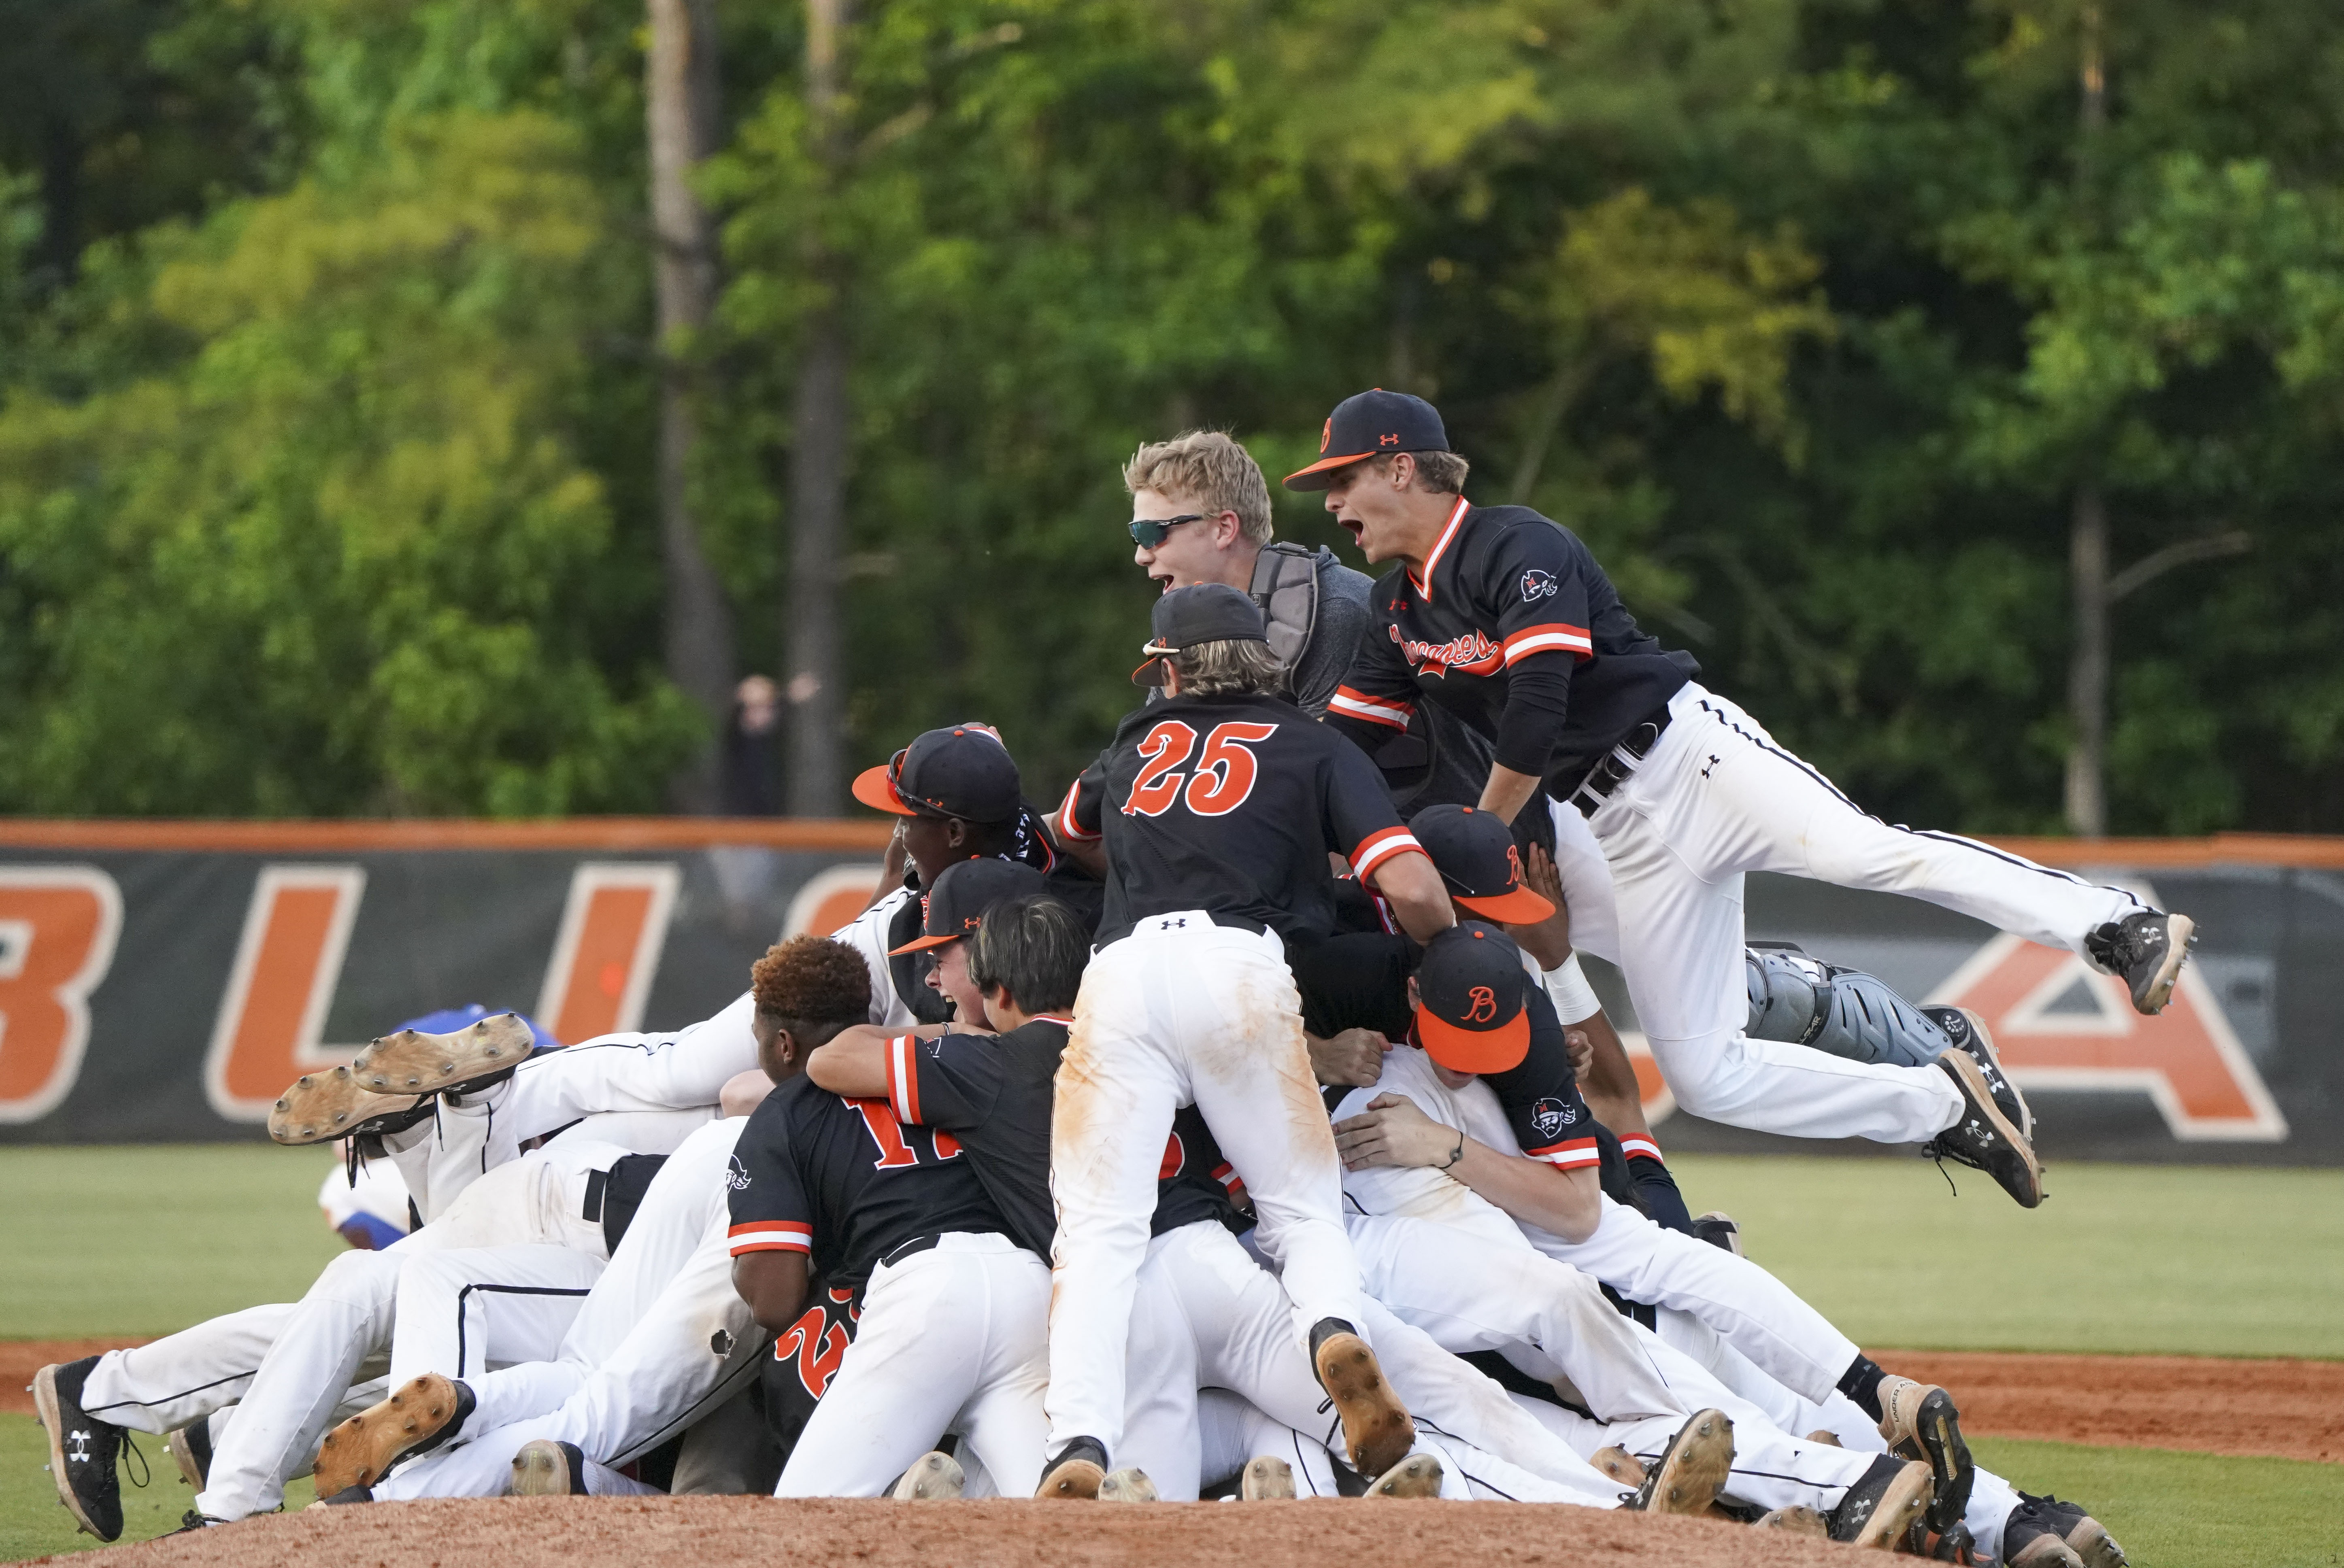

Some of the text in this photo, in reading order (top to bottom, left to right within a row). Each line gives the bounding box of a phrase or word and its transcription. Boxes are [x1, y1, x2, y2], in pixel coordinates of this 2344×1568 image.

[1121, 720, 1279, 817] 25
[1460, 986, 1497, 1023] B
[840, 1096, 964, 1171] 1
[774, 1287, 861, 1402] 2
